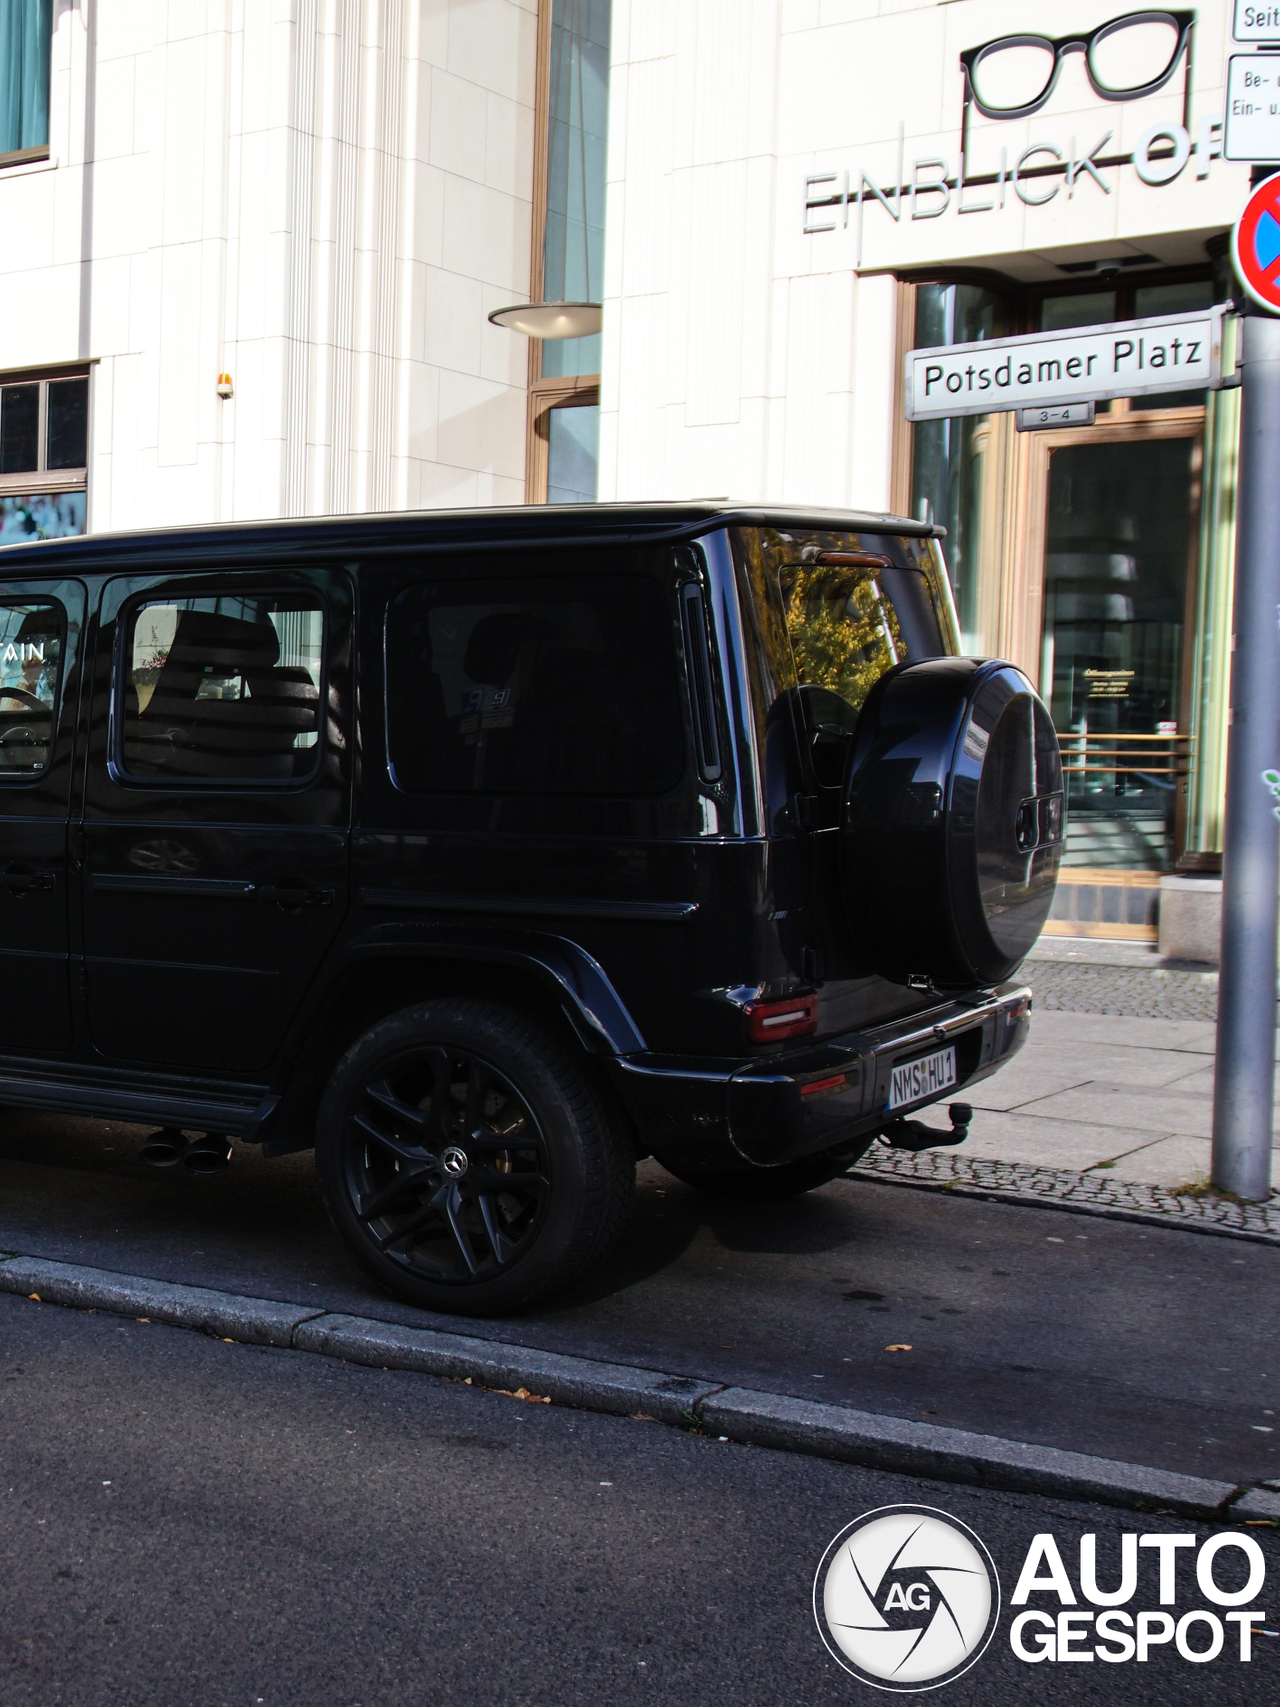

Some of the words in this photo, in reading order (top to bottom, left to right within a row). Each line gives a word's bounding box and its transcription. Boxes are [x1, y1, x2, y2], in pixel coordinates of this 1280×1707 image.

[1244, 71, 1270, 87] Be-
[1232, 99, 1262, 116] Ein-
[803, 120, 1114, 267] EINBLICK
[925, 355, 1098, 397] Potsdamer
[1113, 337, 1203, 373] Platz
[1040, 408, 1071, 422] 3-4
[893, 1064, 921, 1104] NMS
